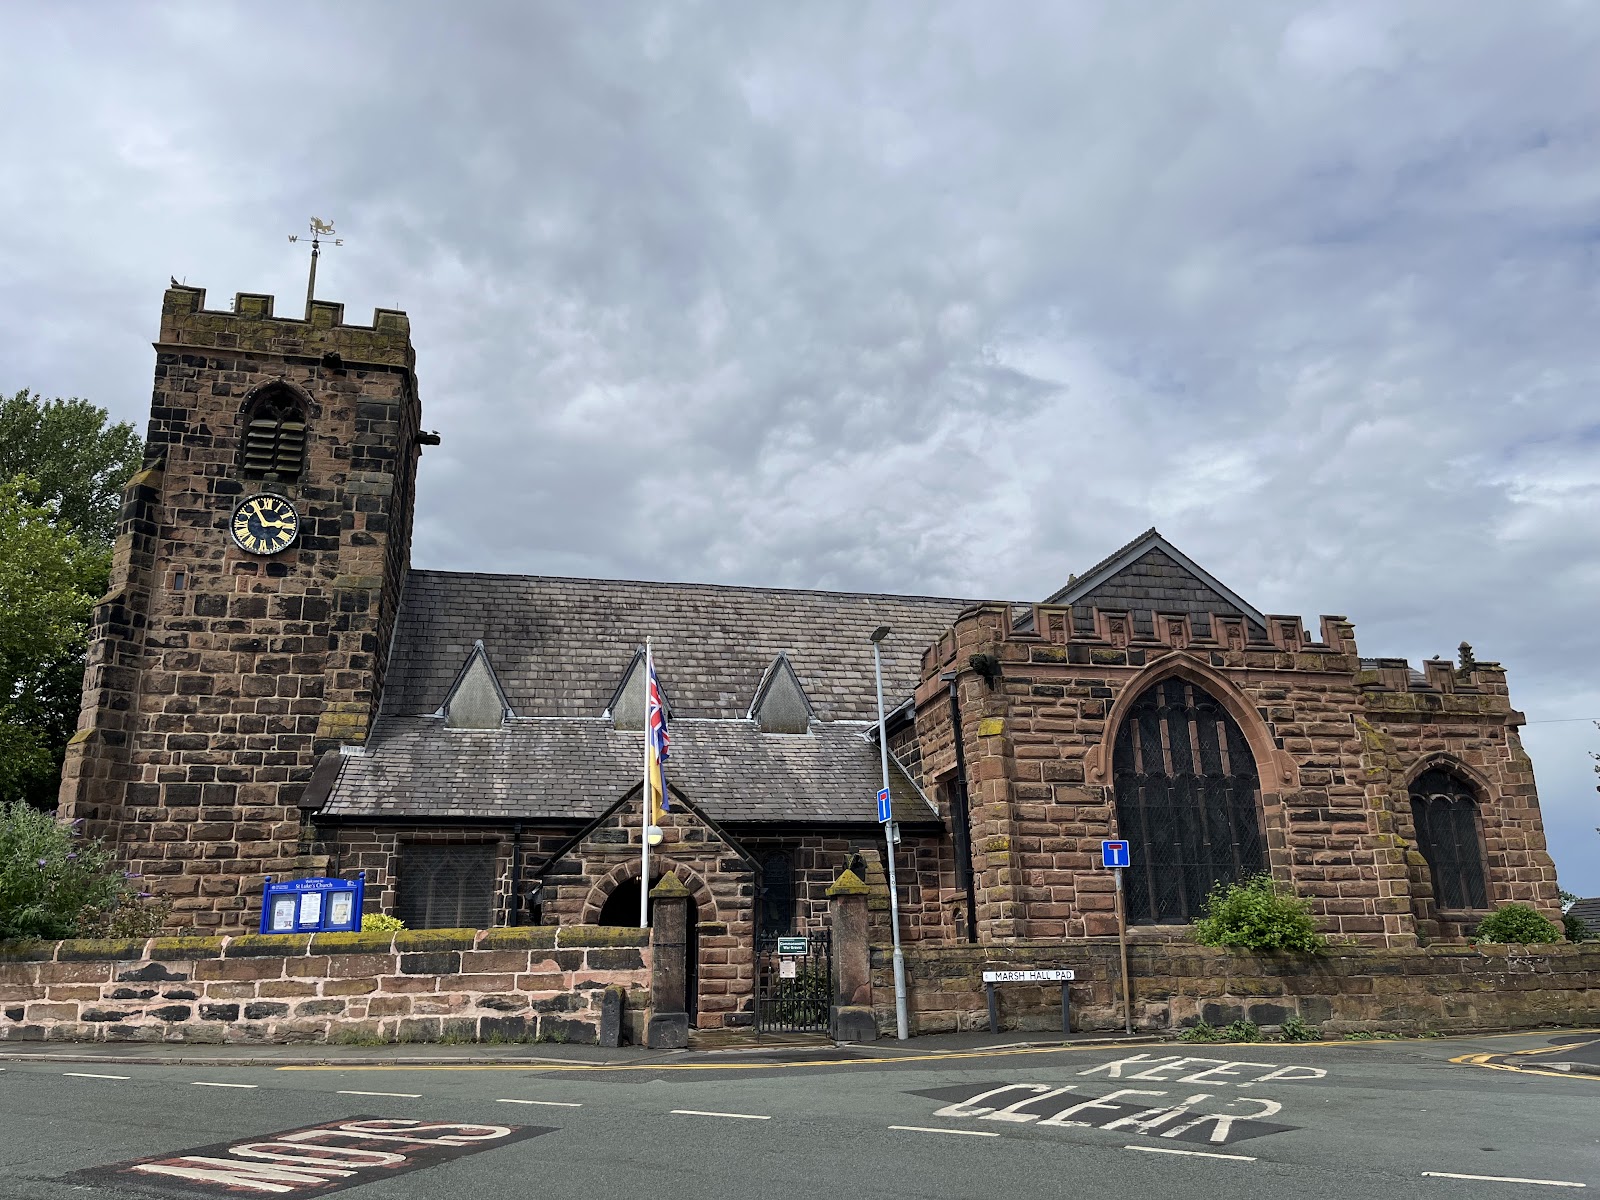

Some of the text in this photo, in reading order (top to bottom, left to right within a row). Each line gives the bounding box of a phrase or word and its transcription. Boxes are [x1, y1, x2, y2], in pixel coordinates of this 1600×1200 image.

[996, 972, 1025, 980] MARSH
[1056, 971, 1072, 979] PAD
[1076, 1053, 1328, 1088] KEEP
[932, 1083, 1282, 1143] CLEAR
[131, 1118, 512, 1194] SLOW
